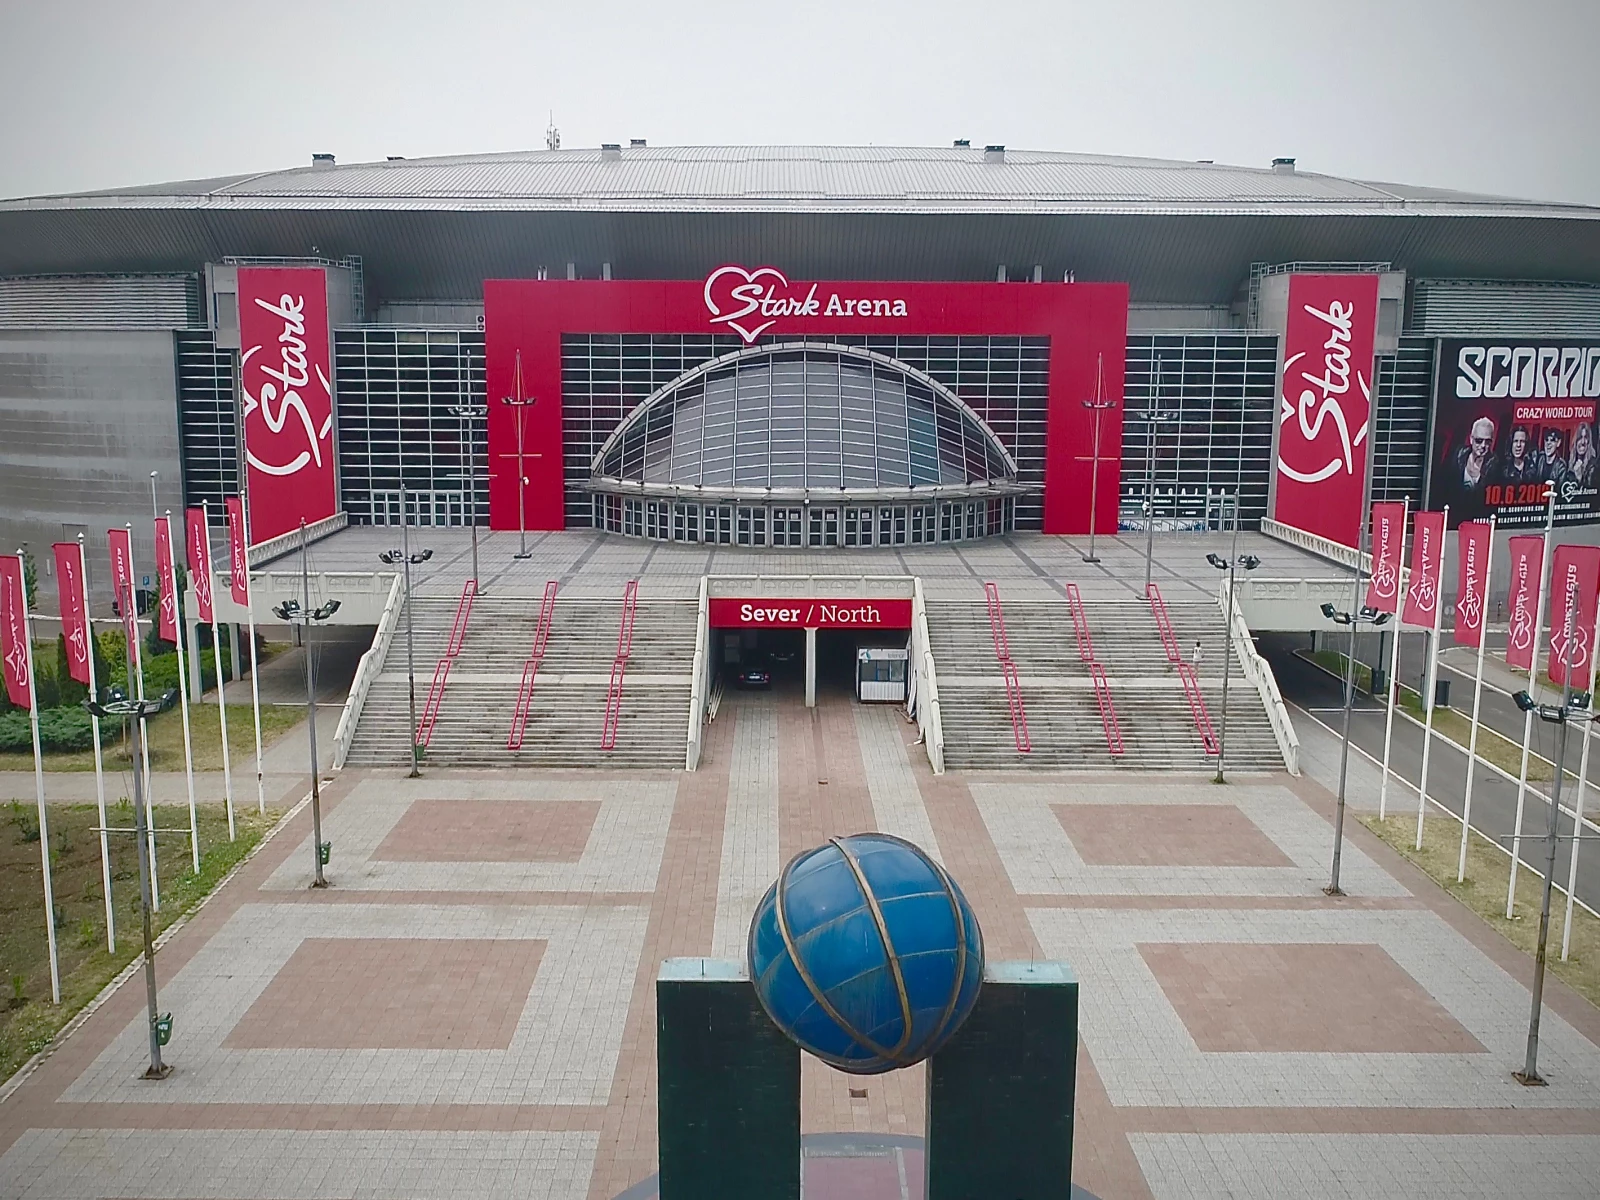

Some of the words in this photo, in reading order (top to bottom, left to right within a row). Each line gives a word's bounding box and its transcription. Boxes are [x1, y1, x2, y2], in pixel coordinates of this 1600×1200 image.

[709, 283, 820, 323] Stark
[823, 294, 908, 317] Arena
[254, 293, 323, 468] Stark
[1298, 299, 1354, 475] Stark
[1516, 406, 1545, 419] CRAZY
[1545, 406, 1573, 419] WORLD
[1574, 405, 1593, 418] TOUR
[740, 604, 801, 622] Sever
[805, 604, 814, 623] /
[819, 604, 881, 623] North
